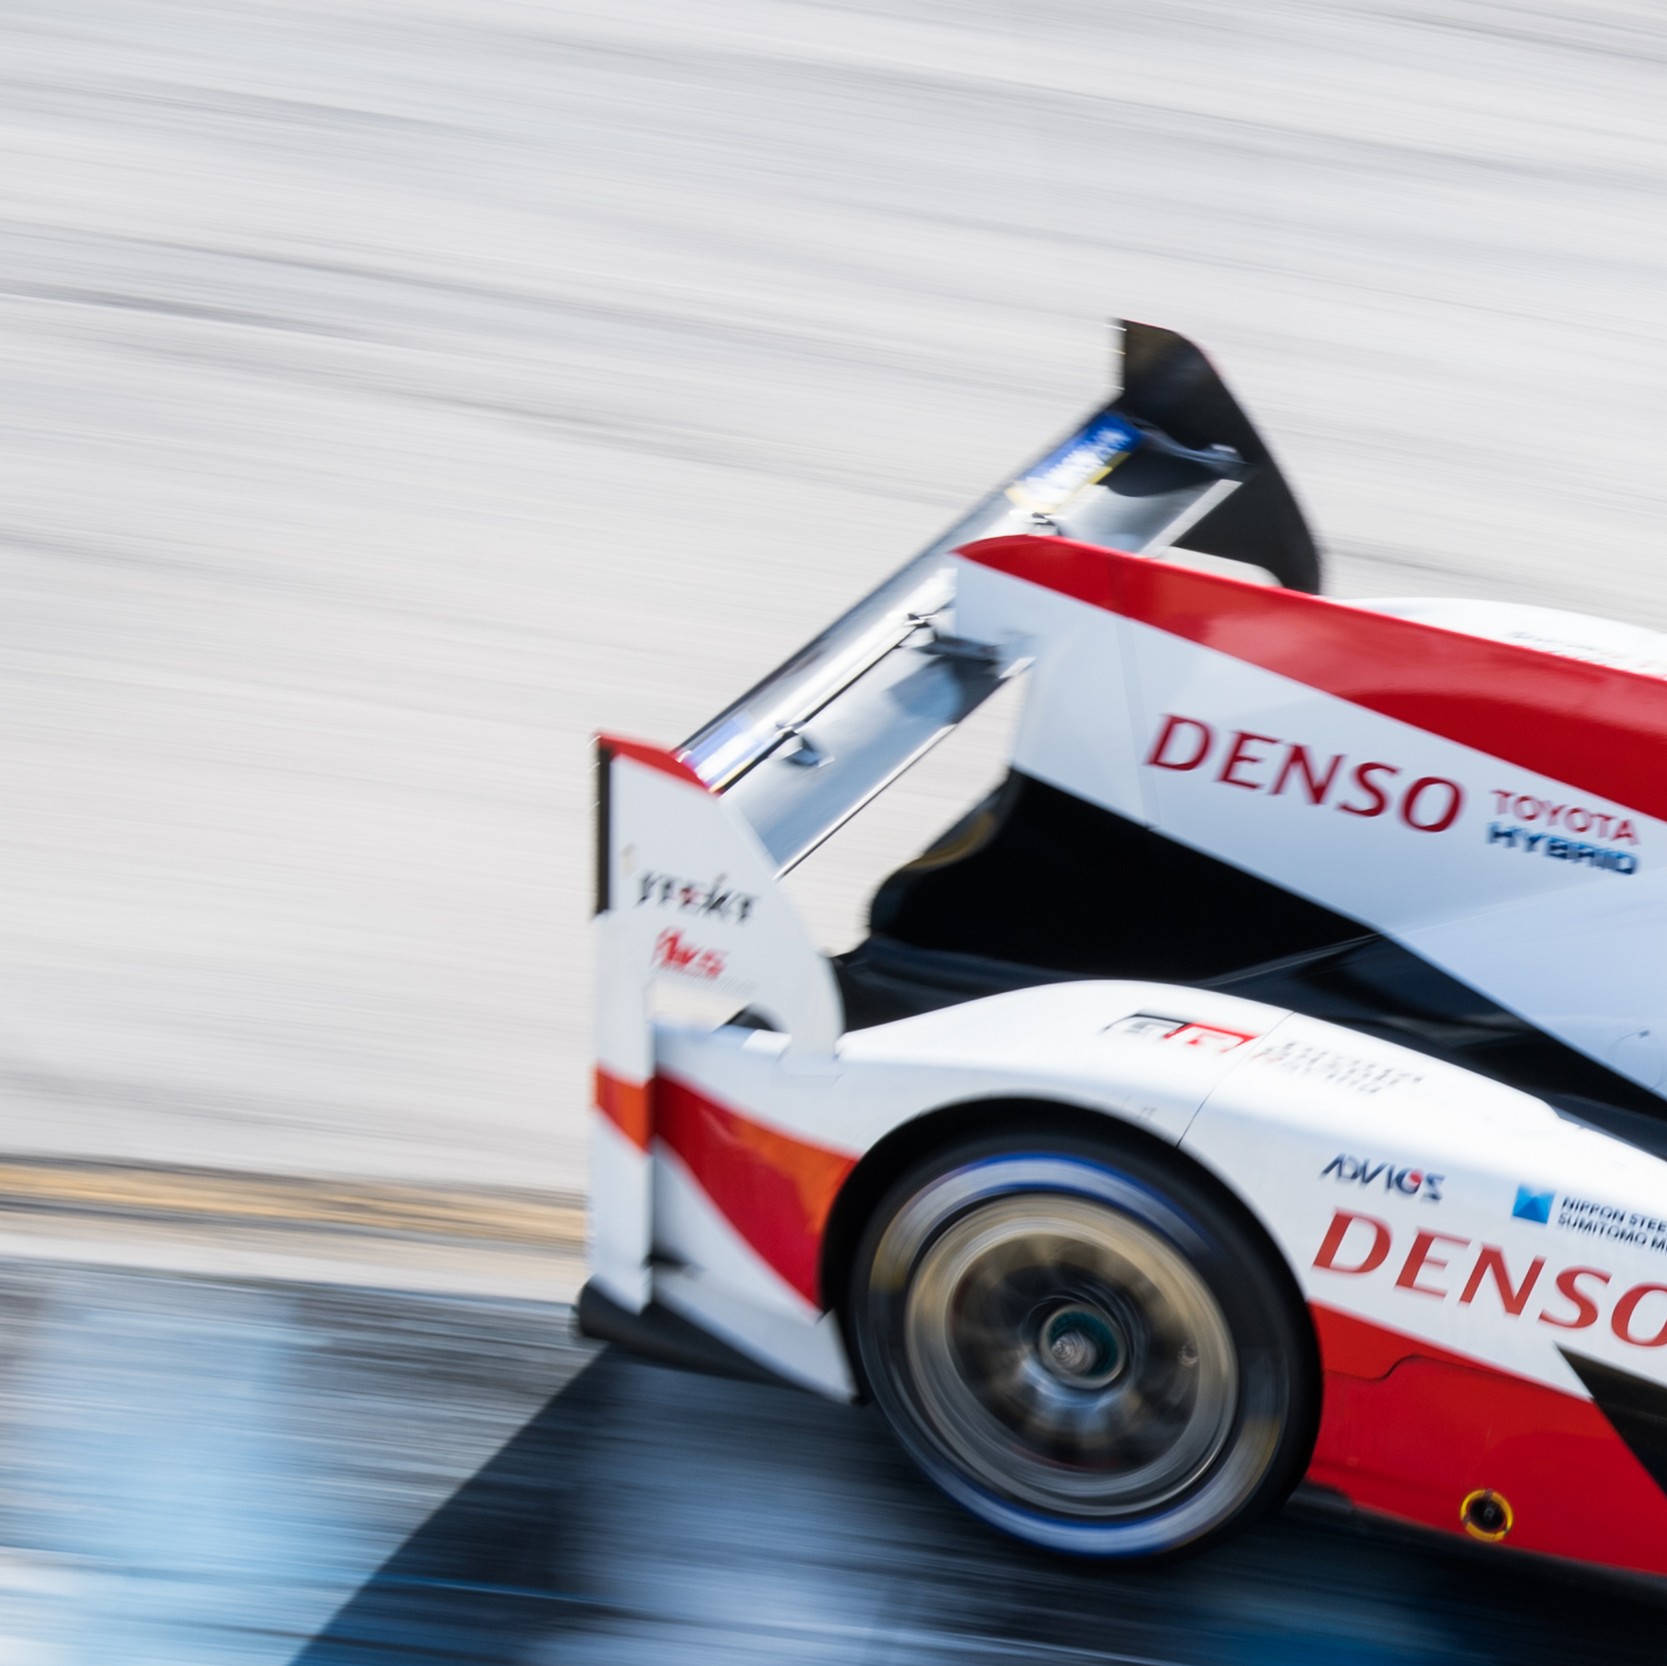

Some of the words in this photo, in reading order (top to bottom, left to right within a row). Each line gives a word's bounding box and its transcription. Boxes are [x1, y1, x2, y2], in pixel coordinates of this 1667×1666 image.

[1144, 712, 1467, 834] DENSO
[1490, 788, 1642, 847] TOYOTA
[1484, 821, 1641, 876] HYBRID
[1557, 1212, 1649, 1246] SUMITOMO
[1561, 1195, 1626, 1224] NIPPON
